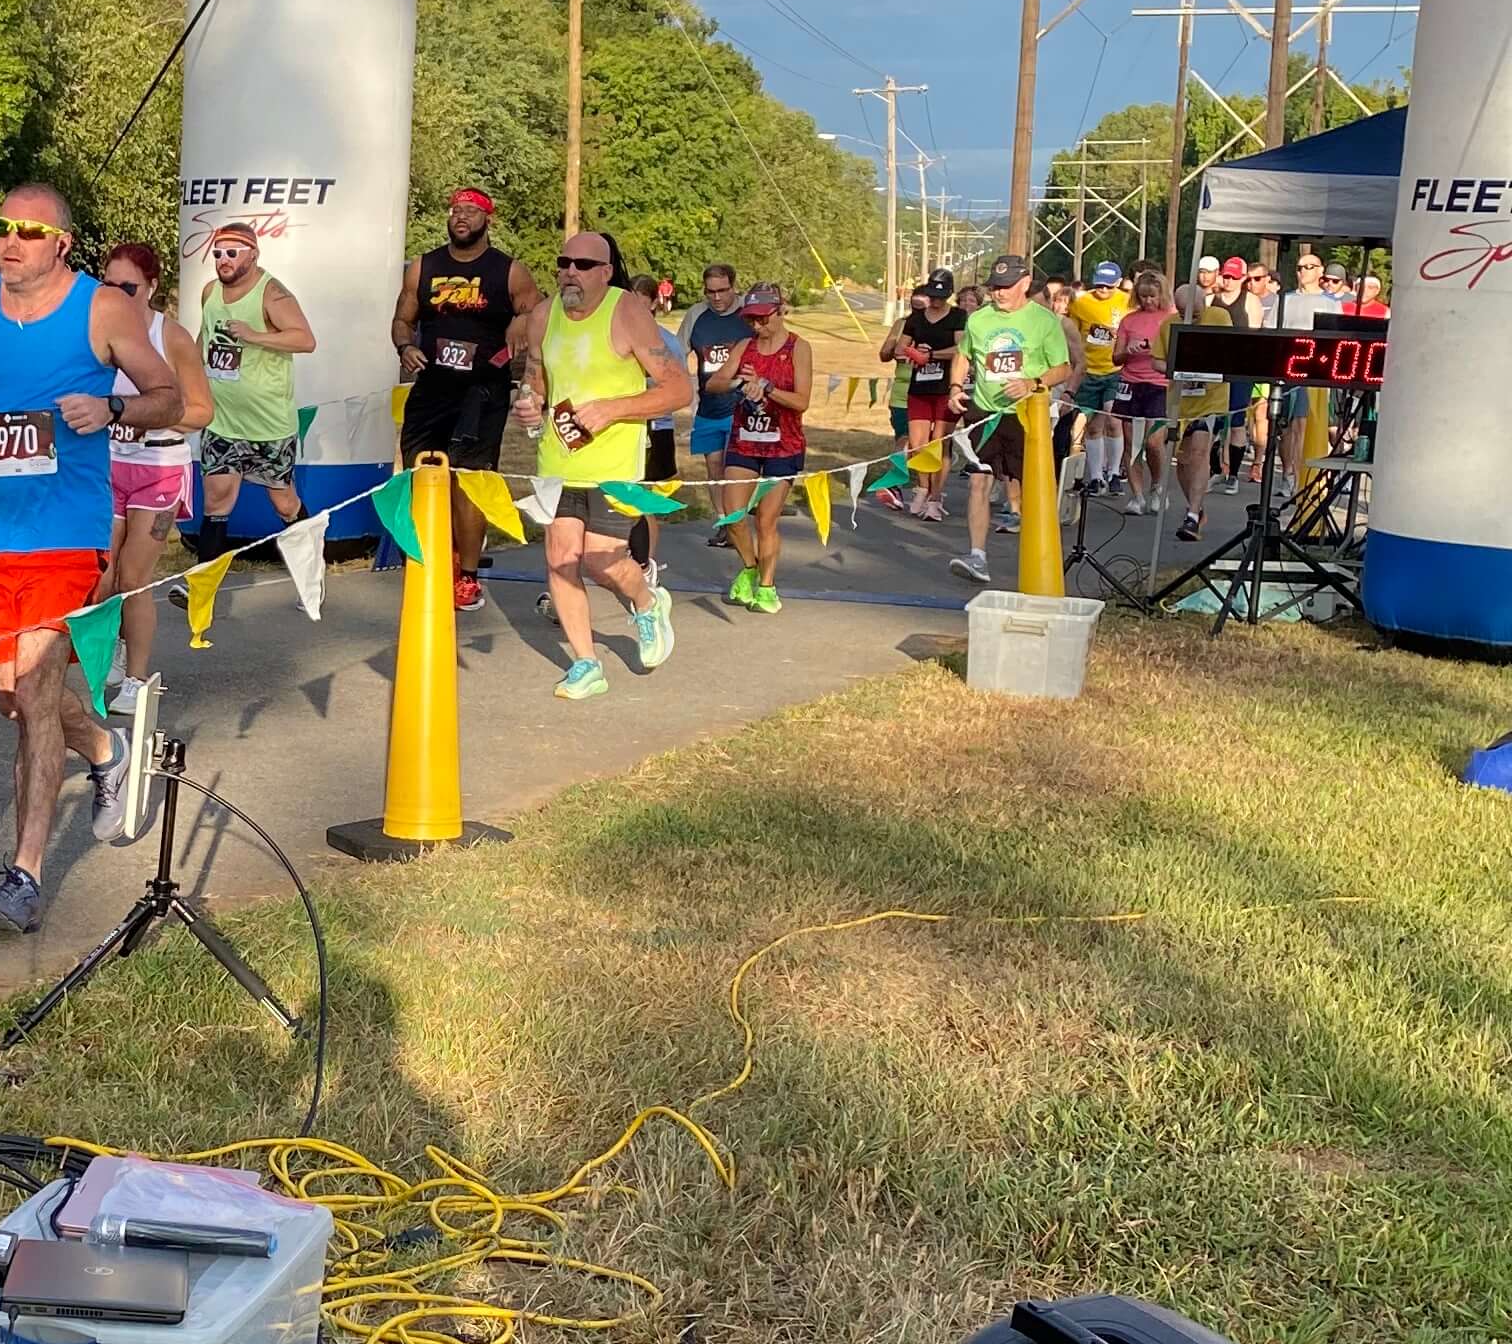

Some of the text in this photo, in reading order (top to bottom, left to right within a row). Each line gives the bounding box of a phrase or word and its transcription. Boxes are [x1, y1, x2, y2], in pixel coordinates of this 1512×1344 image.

[180, 177, 337, 206] LEET FEET
[1411, 178, 1512, 213] FLEE
[212, 351, 234, 369] 942
[442, 346, 467, 366] 932
[709, 348, 730, 363] 965
[993, 356, 1016, 374] 945
[555, 411, 582, 443] 968
[747, 415, 772, 431] 967
